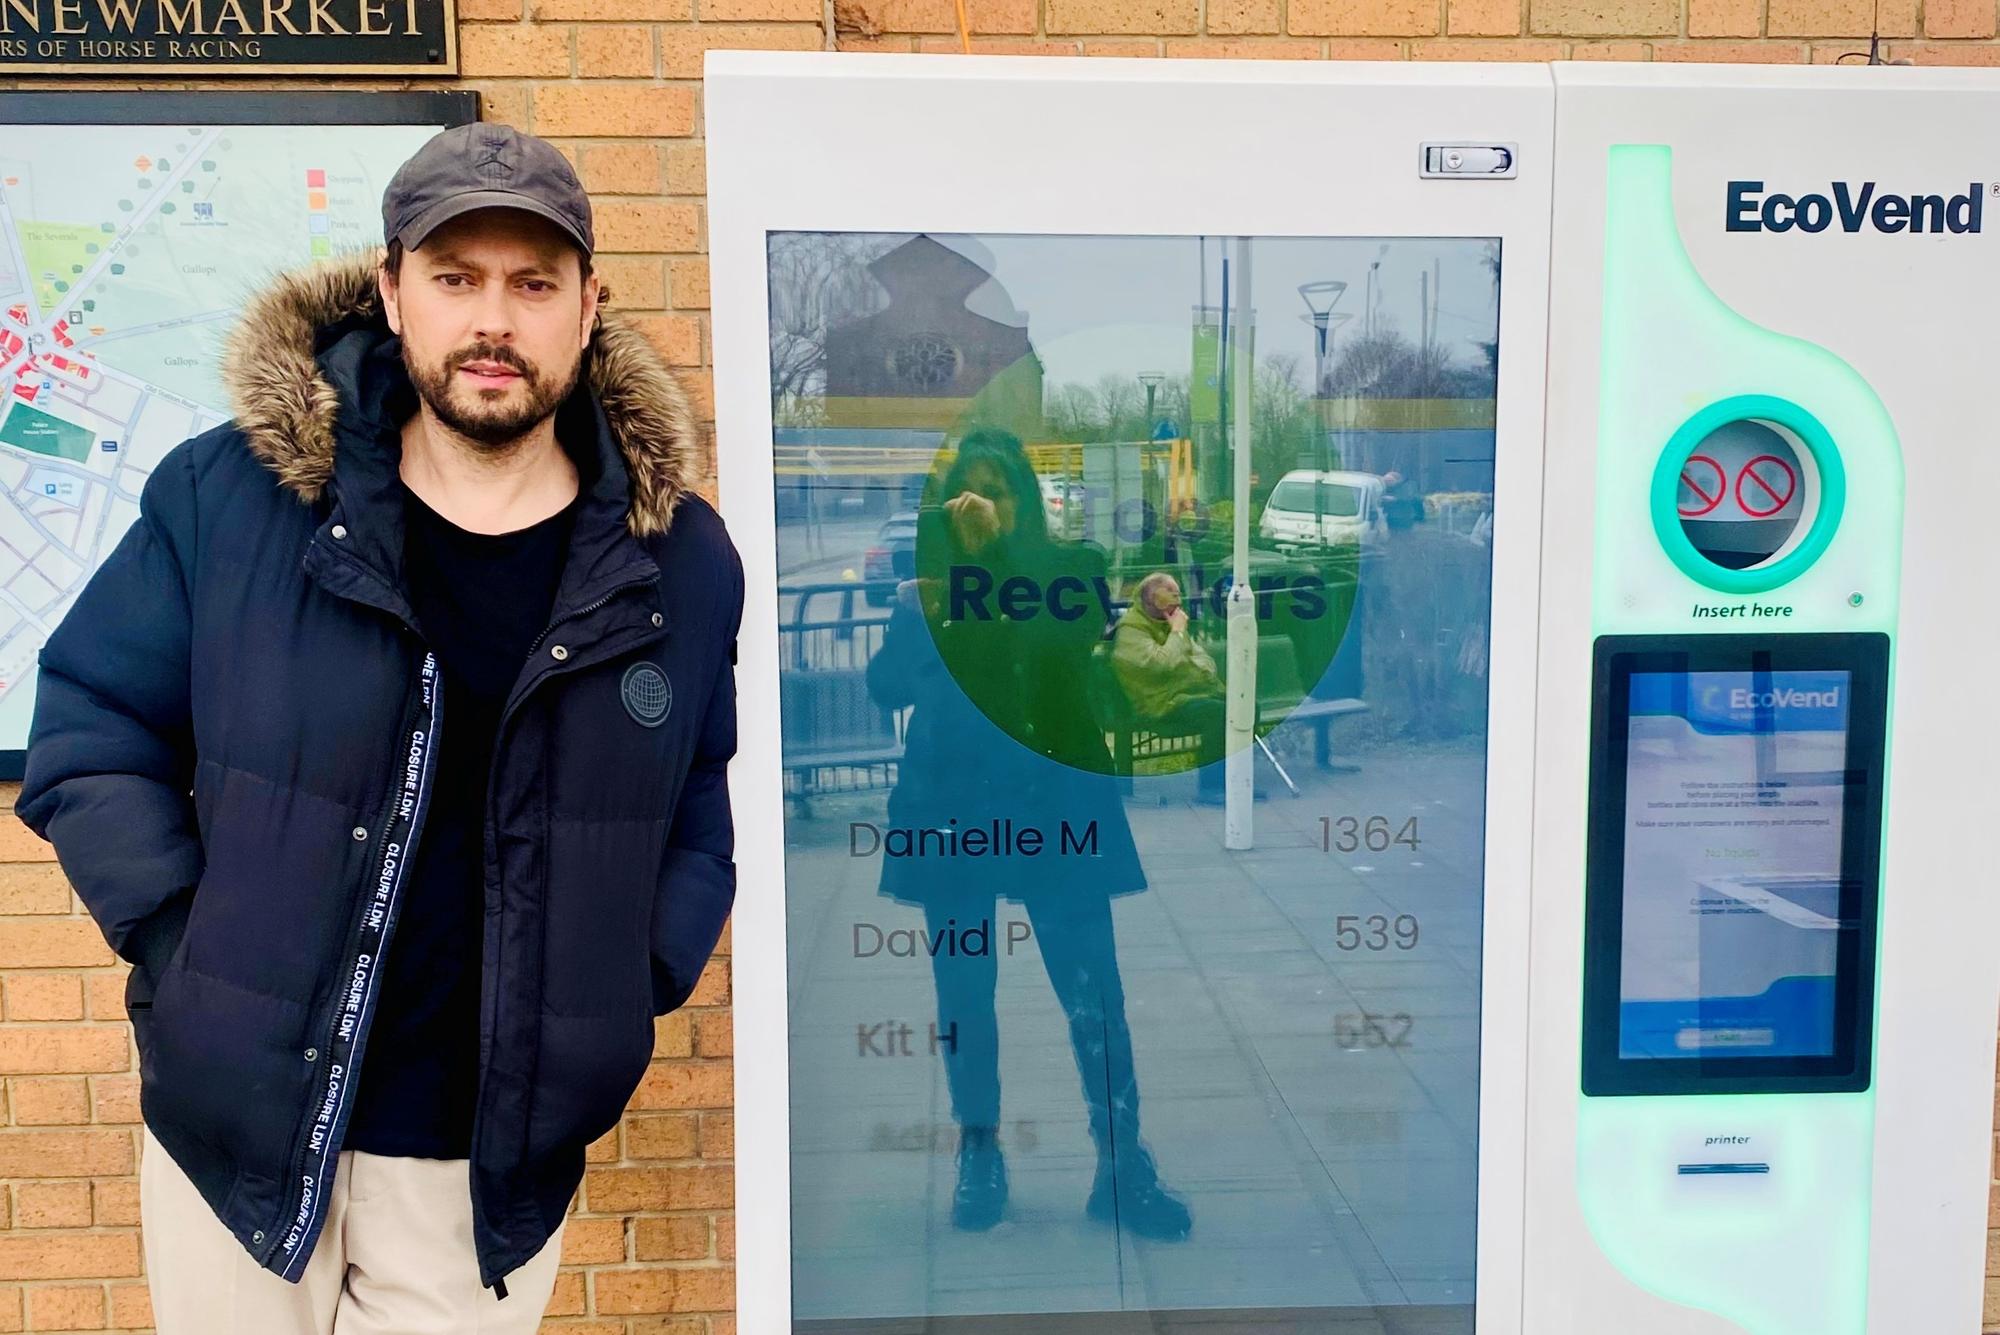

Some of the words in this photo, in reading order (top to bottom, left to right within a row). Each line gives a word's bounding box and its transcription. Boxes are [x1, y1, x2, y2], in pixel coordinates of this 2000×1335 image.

[0, 0, 430, 36] NEWMARKET
[38, 40, 67, 58] OF
[79, 40, 157, 58] HORSE
[169, 41, 262, 59] RACING
[1725, 181, 1984, 234] EcoVend
[182, 264, 217, 277] Gallops
[163, 356, 200, 369] Gallops
[1692, 604, 1747, 618] Insert
[1751, 602, 1793, 617] here
[1730, 686, 1840, 709] EcoVend
[405, 730, 425, 790] CLOSURE
[849, 818, 1044, 858] Danielle
[1059, 820, 1099, 857] M
[1319, 815, 1422, 853] 1364
[376, 842, 401, 901] CLOSURE
[852, 918, 989, 958] David
[1006, 920, 1032, 957] P
[1336, 914, 1420, 951] 539
[346, 953, 371, 1012] CLOSURE
[857, 1020, 915, 1058] Kit
[928, 1021, 958, 1056] H
[318, 1064, 343, 1125] CLOSURE
[1705, 1134, 1751, 1147] printer
[296, 1175, 314, 1229] CLOSURE
